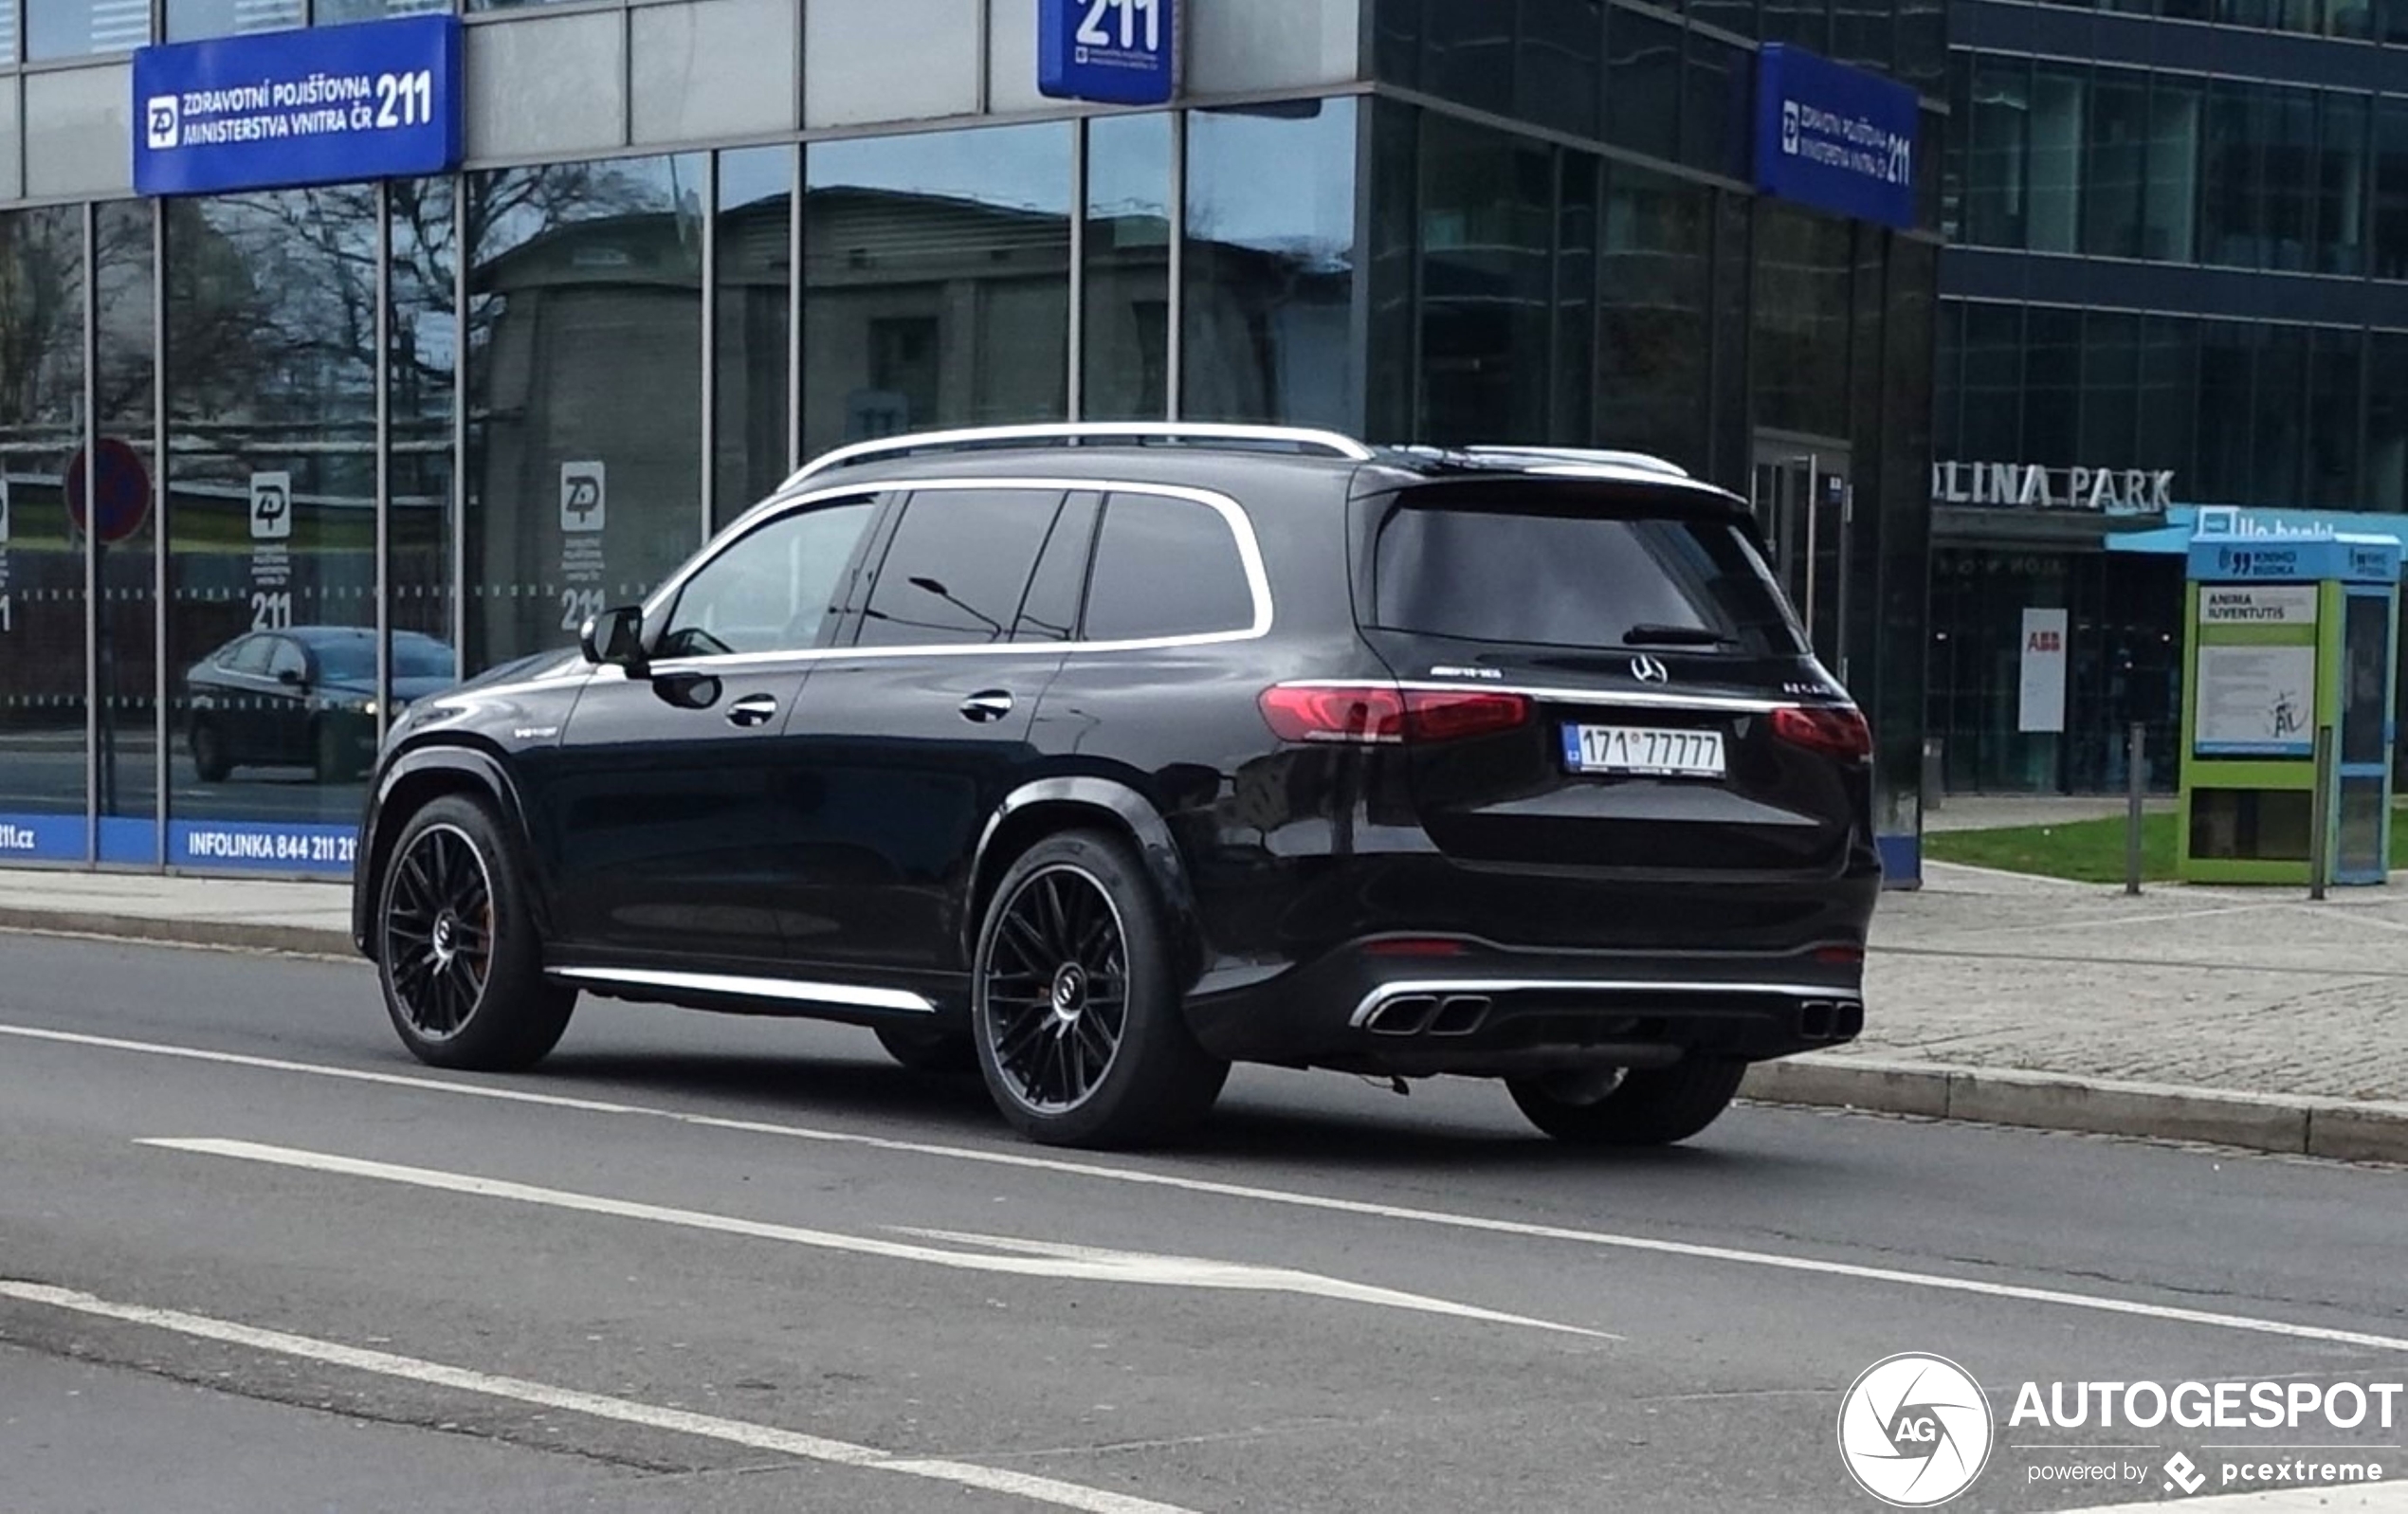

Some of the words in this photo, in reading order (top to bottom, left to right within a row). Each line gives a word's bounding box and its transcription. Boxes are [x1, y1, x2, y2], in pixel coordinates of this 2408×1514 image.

[1076, 0, 1158, 51] 211
[184, 79, 270, 115] ZDRAVOTNÍ
[274, 73, 371, 107] POJIŠŤOVNA
[377, 69, 430, 127] 211
[183, 112, 287, 145] MINISTERSTVA
[291, 108, 347, 135] VNITRA
[350, 100, 372, 129] ČR
[1887, 132, 1910, 185] 211
[2070, 466, 2175, 511] PARK
[251, 592, 291, 630] 211
[561, 588, 605, 630] 211
[2209, 593, 2253, 606] ANIMA
[2209, 607, 2285, 619] IUVENTUTIS
[2028, 631, 2059, 651] ABB
[1583, 729, 1629, 763] 171
[1644, 732, 1718, 767] 77777
[189, 832, 274, 858] INFOLINKA
[277, 834, 308, 859] 844
[312, 836, 335, 860] 211
[338, 836, 357, 861] 21
